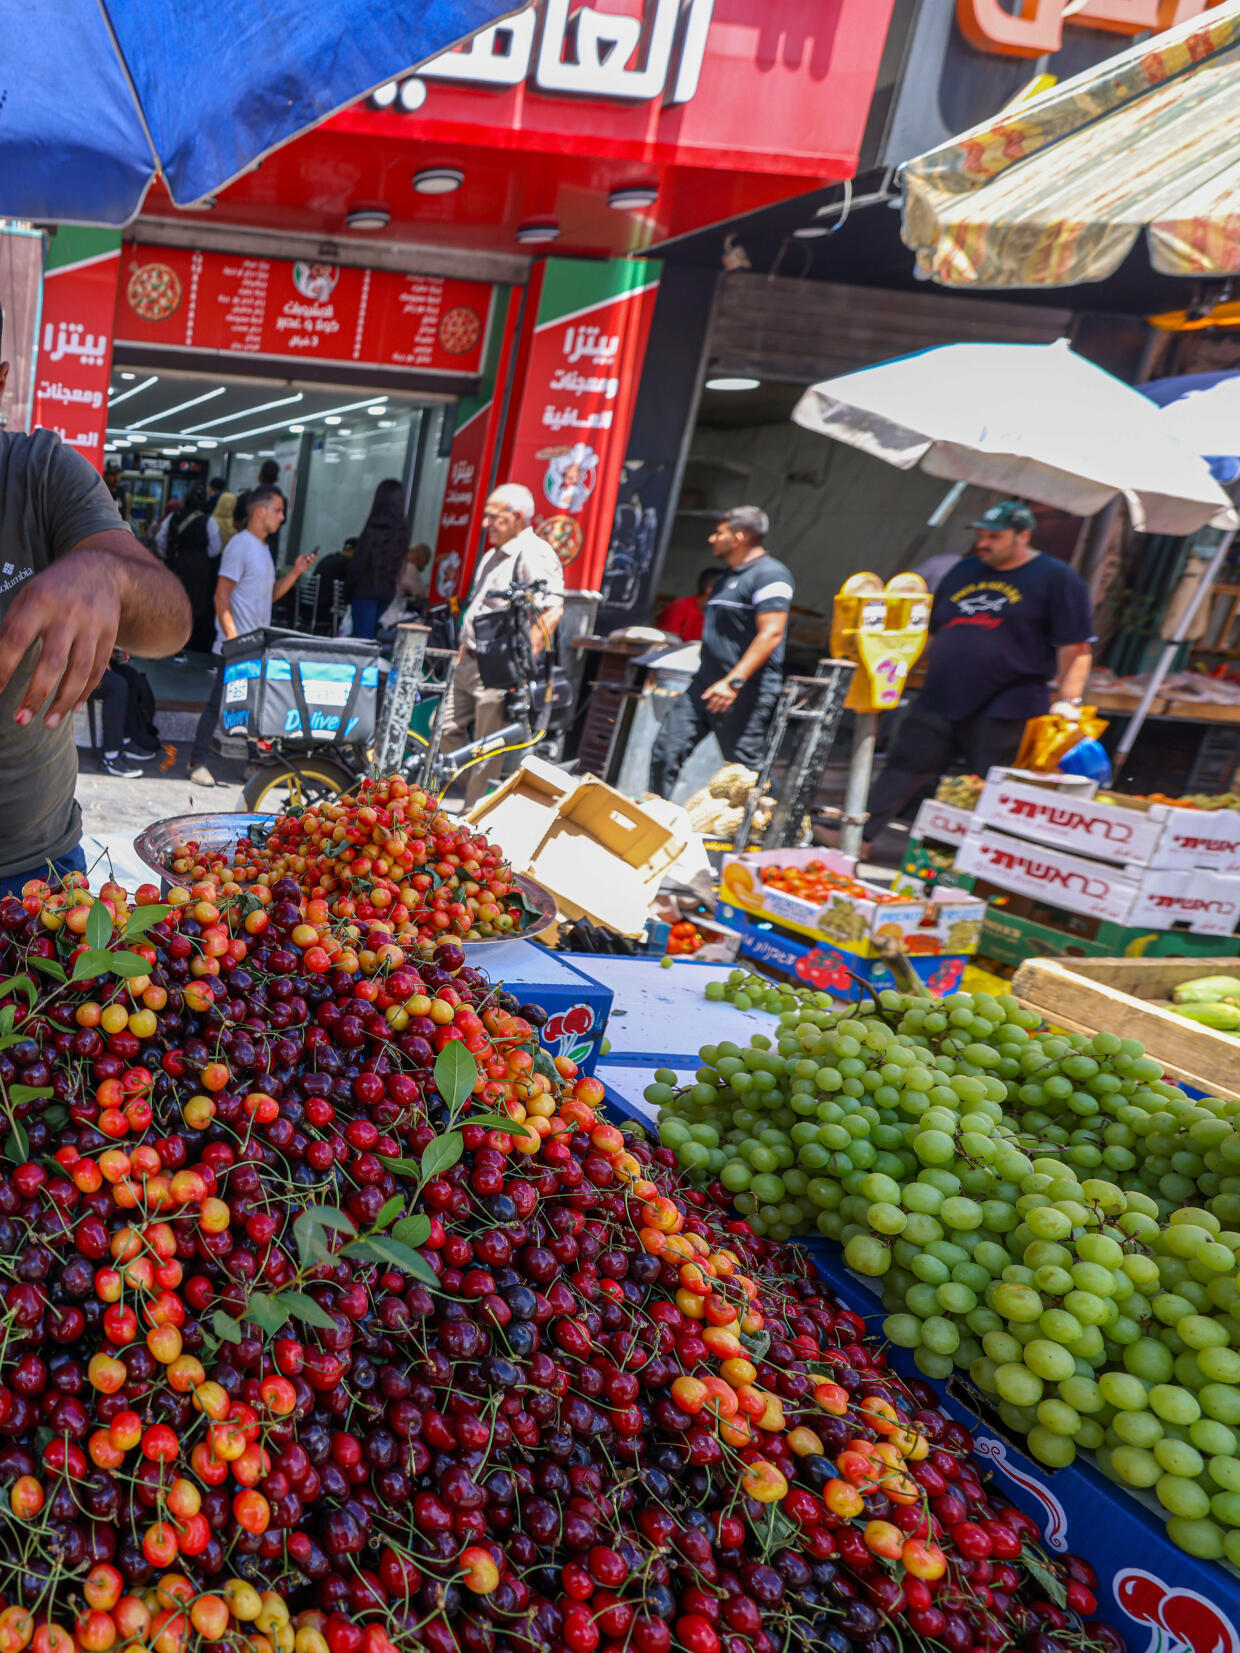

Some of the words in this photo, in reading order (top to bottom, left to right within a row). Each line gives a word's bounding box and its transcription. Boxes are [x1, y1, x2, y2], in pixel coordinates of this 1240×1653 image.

[43, 322, 107, 366] بيتزا
[562, 326, 619, 364] بيتزا
[37, 380, 103, 408] ومعجنات
[549, 369, 619, 398] ومعجنات
[542, 405, 613, 430] العافية
[222, 708, 250, 730] Delivery
